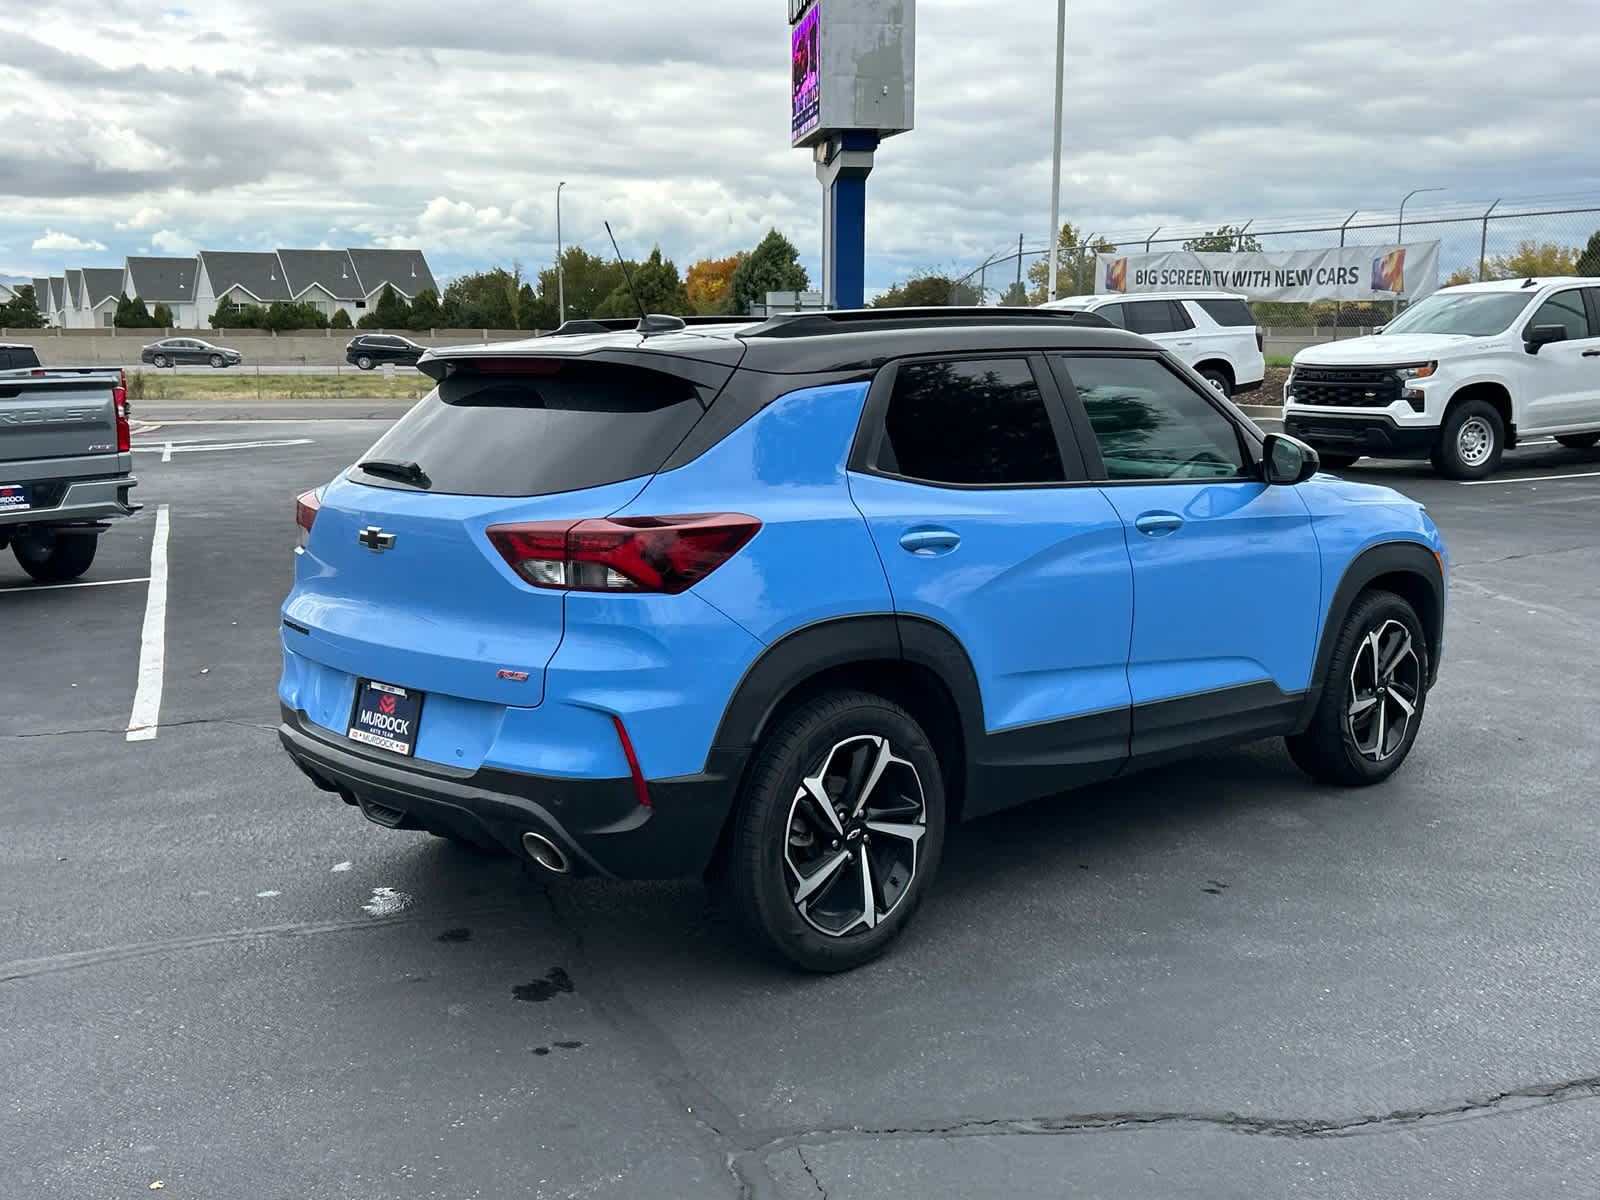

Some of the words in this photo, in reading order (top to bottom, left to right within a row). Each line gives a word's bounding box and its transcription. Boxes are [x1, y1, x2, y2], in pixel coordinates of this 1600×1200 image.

[1135, 269, 1158, 286] BIG
[1160, 268, 1212, 287] SCREEN
[1212, 270, 1230, 288] TV
[1231, 270, 1271, 288] WITH
[1274, 268, 1313, 288] NEW
[1315, 266, 1360, 286] CARS
[360, 709, 410, 736] MURDOCK
[362, 733, 395, 748] MURDOCK
